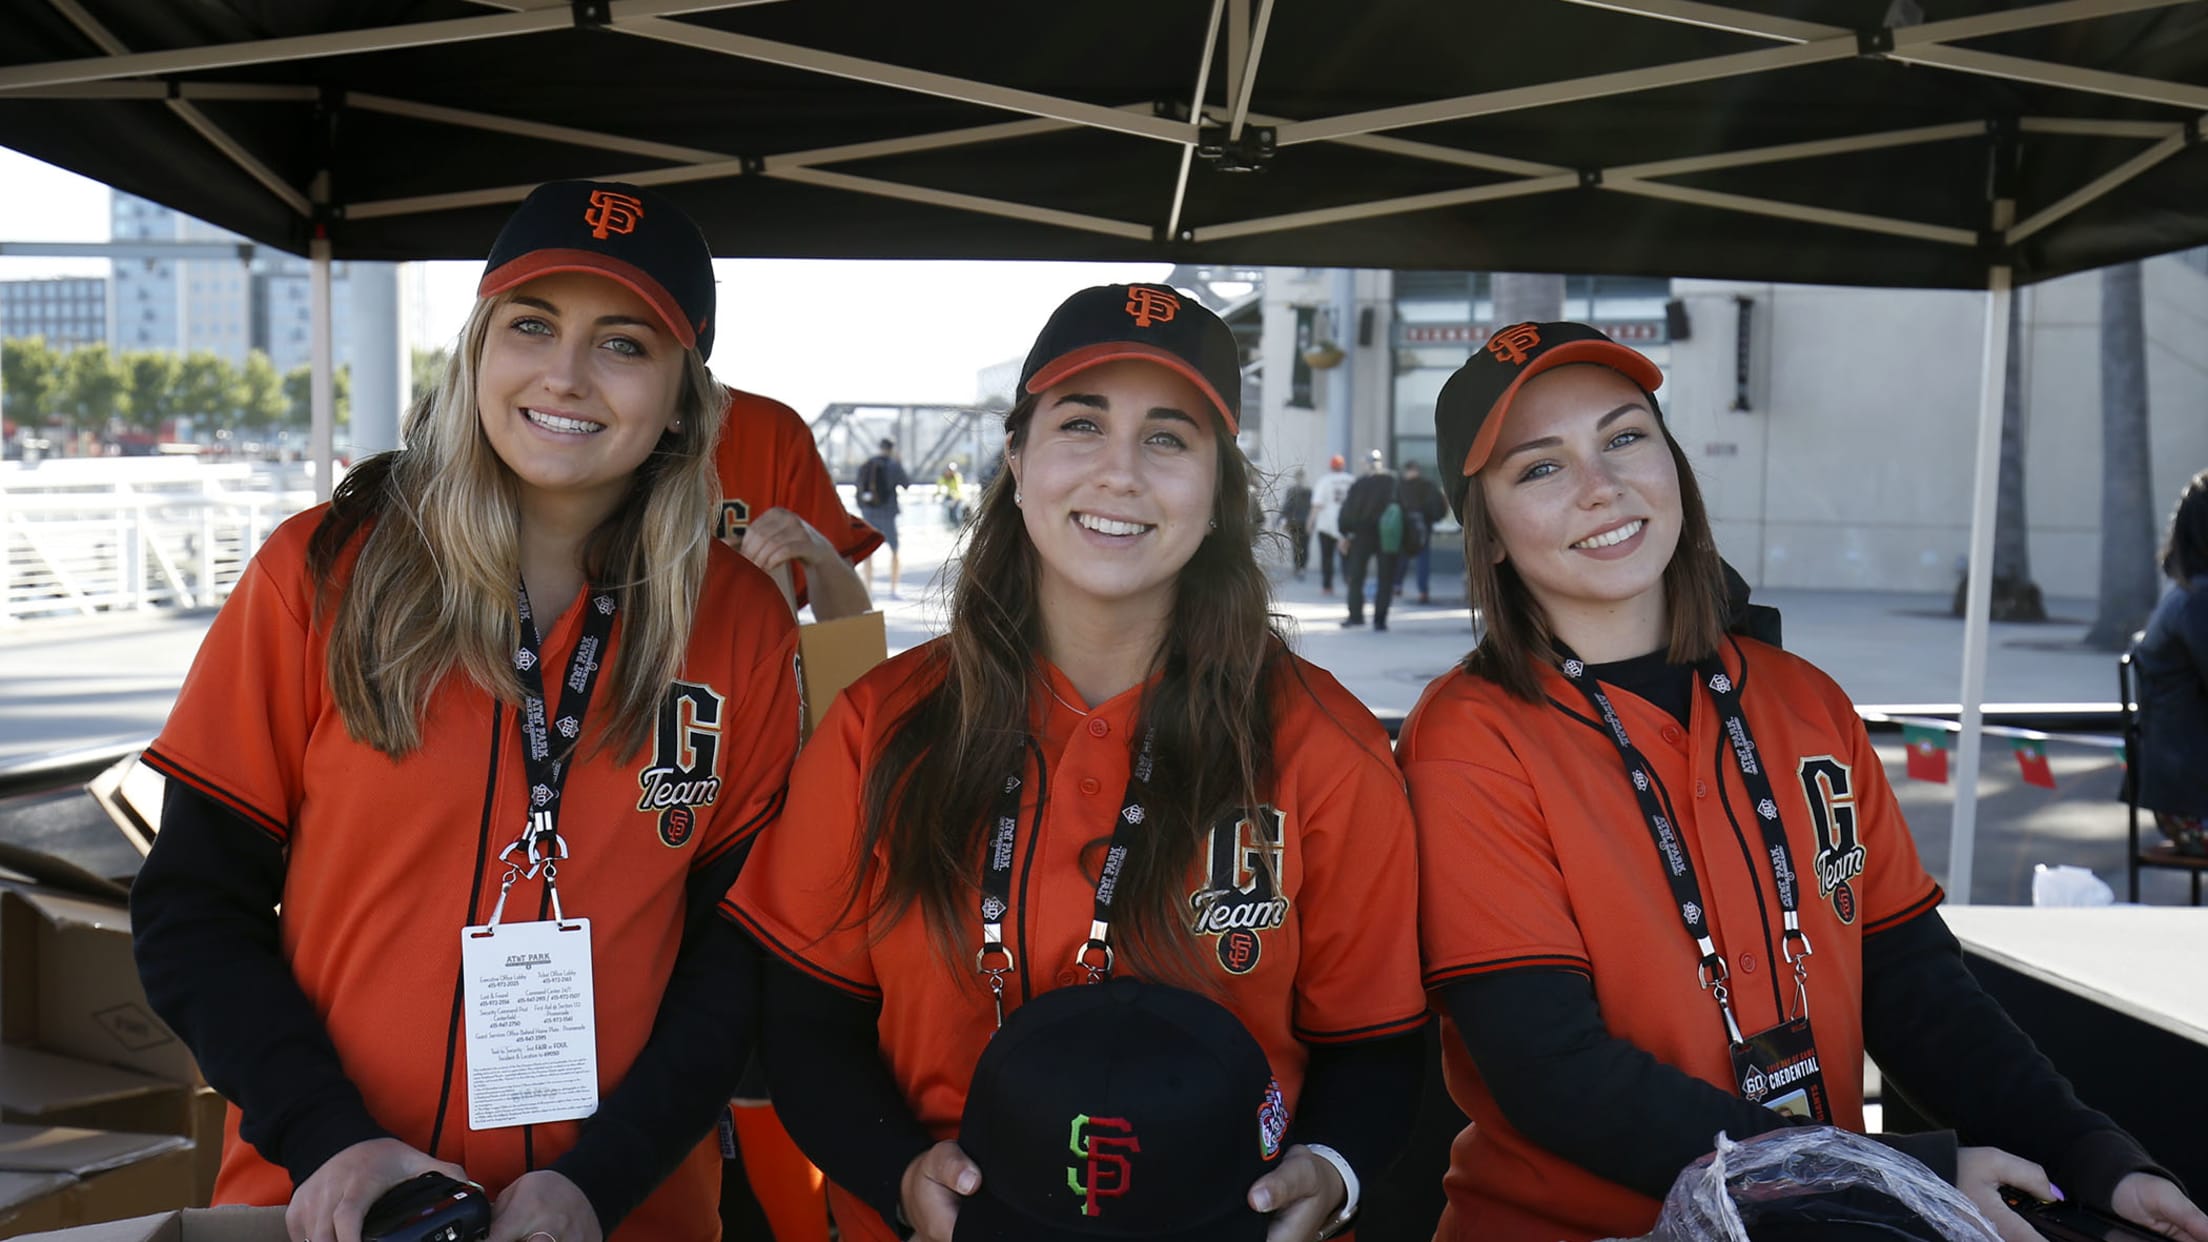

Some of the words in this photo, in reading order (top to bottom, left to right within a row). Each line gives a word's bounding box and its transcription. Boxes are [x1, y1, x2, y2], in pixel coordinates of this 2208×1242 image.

[585, 190, 644, 239] SF
[1125, 286, 1181, 327] SF
[1487, 324, 1541, 365] SF
[654, 680, 726, 776] G
[639, 766, 720, 812] Team
[1797, 754, 1859, 852] G
[1205, 804, 1287, 896] G
[1817, 848, 1865, 897] Team
[1192, 889, 1287, 932] Team
[528, 952, 550, 961] PARK
[1746, 1075, 1764, 1093] 60
[1768, 1057, 1819, 1090] CREDENTIAL
[1067, 1114, 1141, 1216] SF
